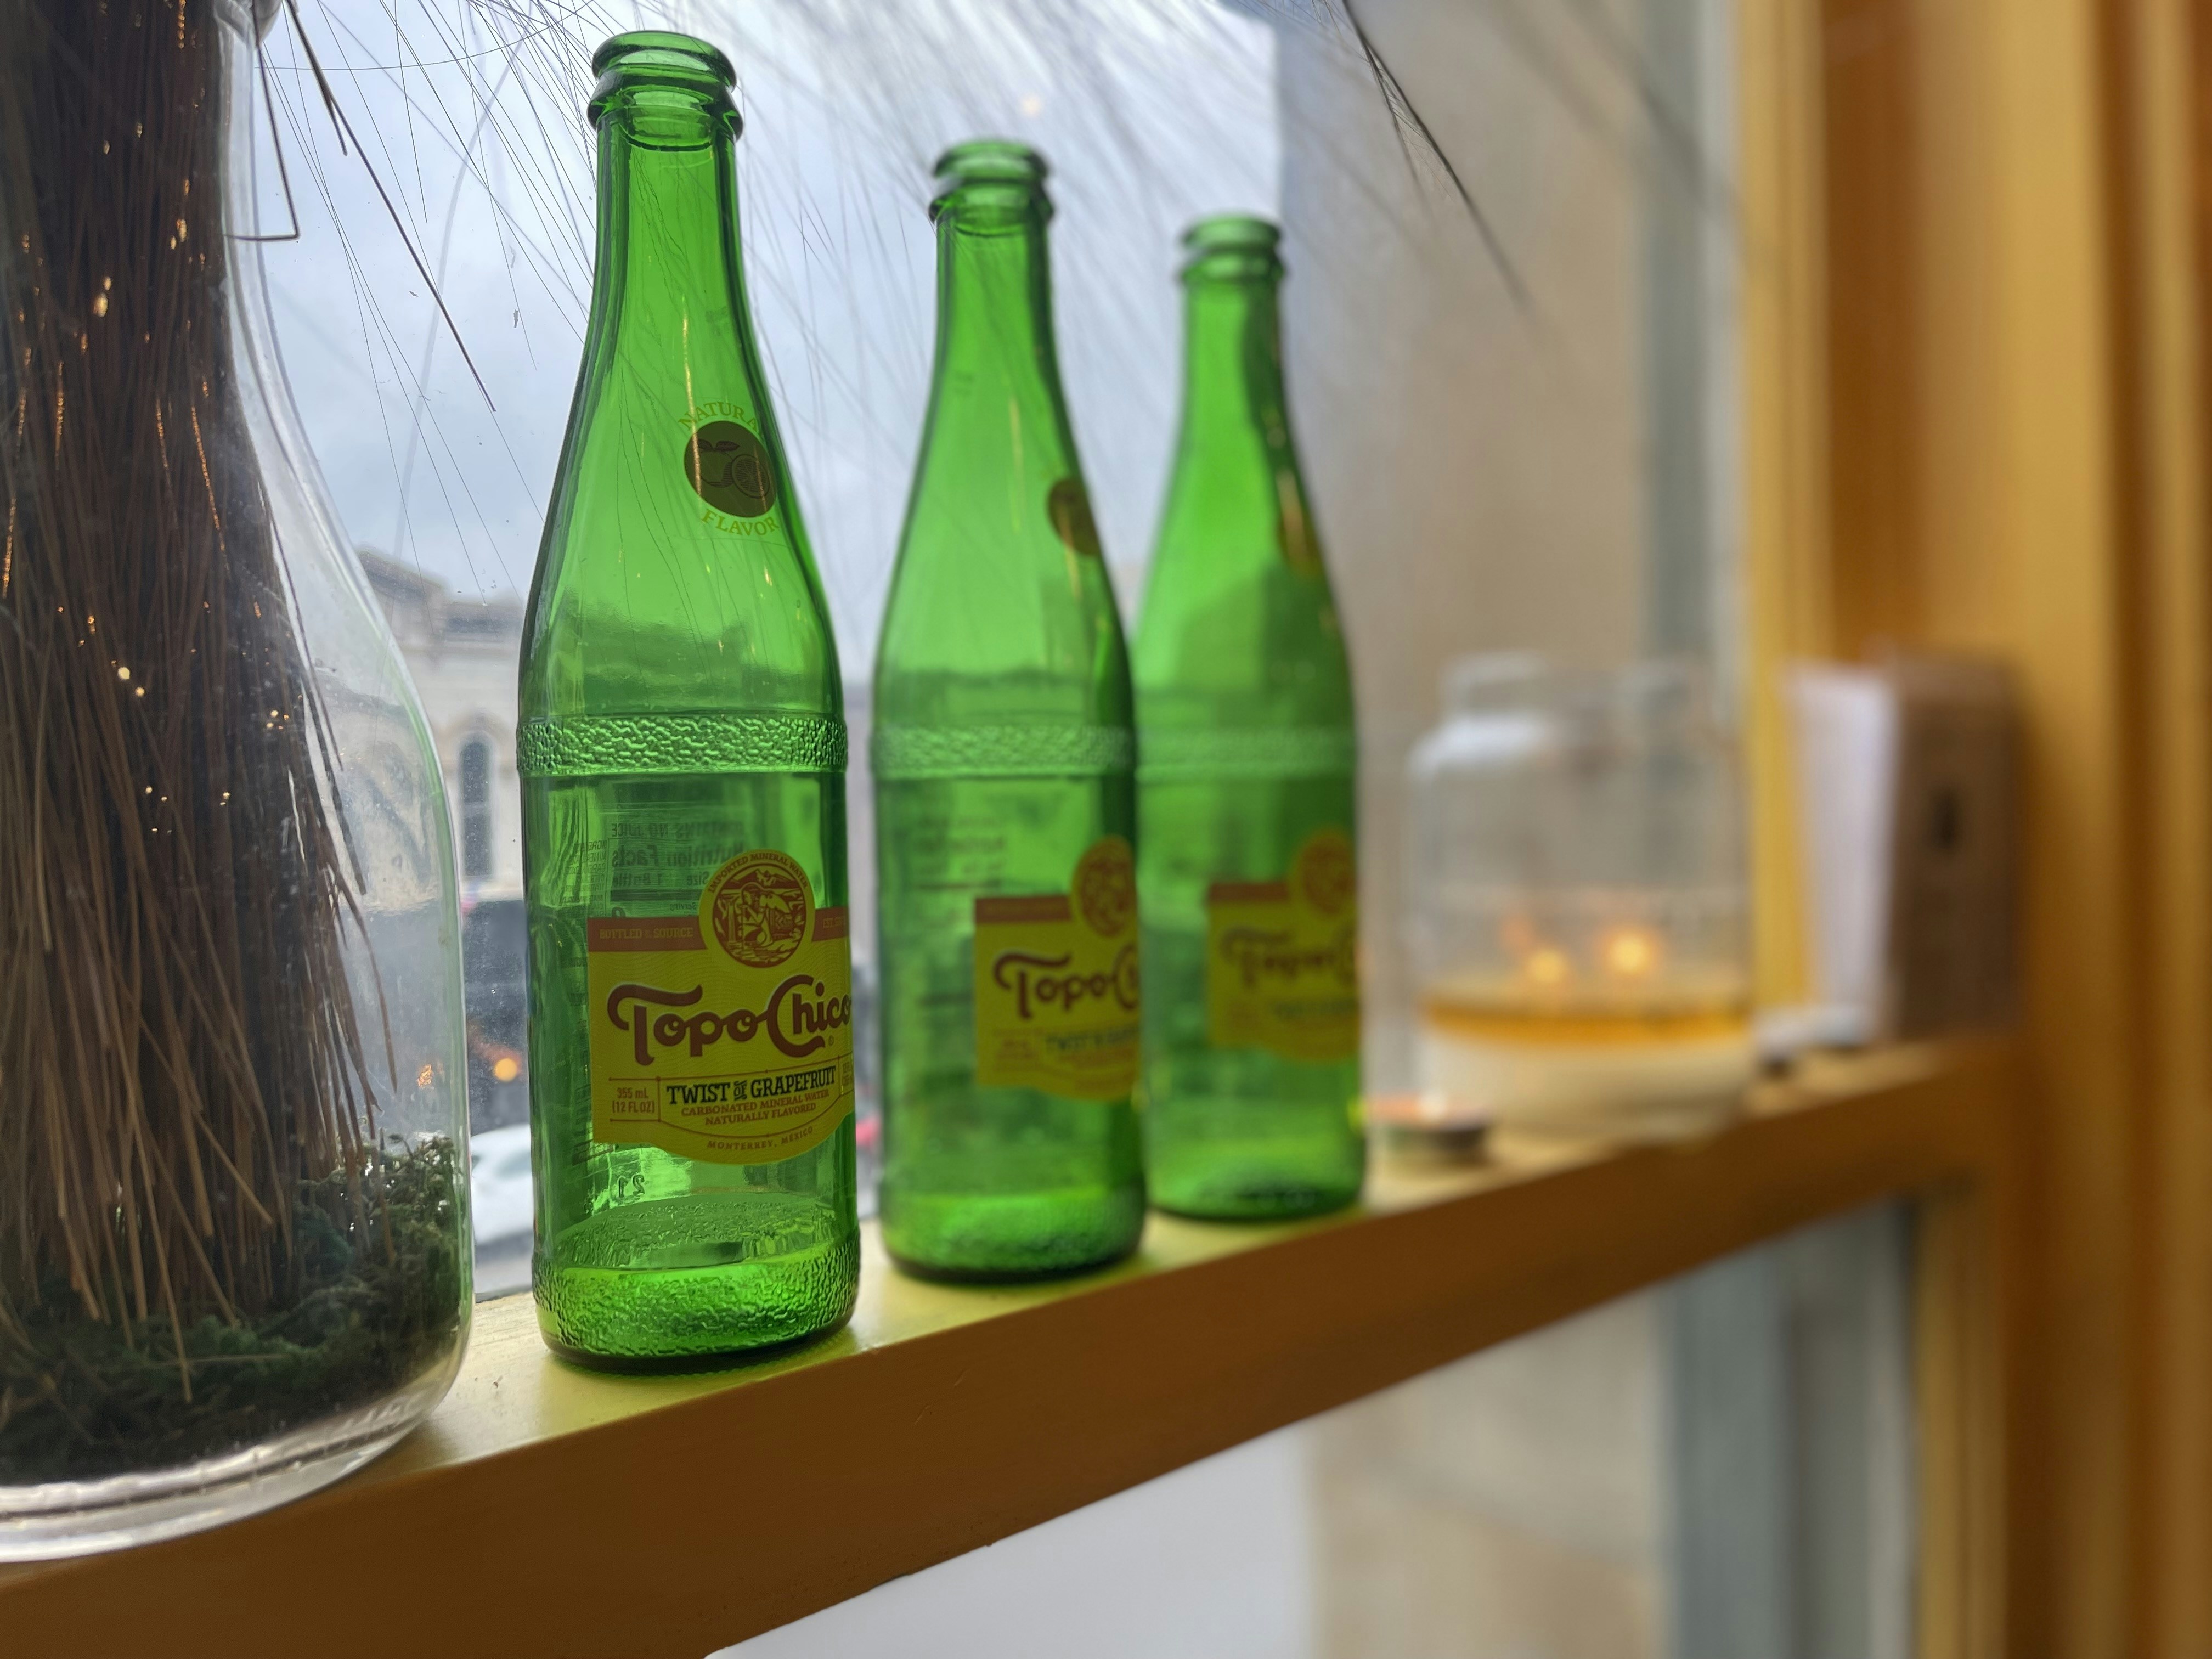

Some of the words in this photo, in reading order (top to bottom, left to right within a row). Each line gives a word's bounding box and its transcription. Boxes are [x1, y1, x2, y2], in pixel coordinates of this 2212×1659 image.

[678, 402, 761, 435] NATURA
[701, 509, 780, 536] FLAVOR
[708, 856, 748, 893] IMPORTED
[751, 853, 788, 866] MINERAL
[788, 860, 808, 889] WATER
[600, 928, 642, 939] BOTTLED
[653, 927, 693, 938] SOURCE
[992, 948, 1108, 1020] Topo
[607, 984, 763, 1065] Topo
[765, 974, 851, 1058] Chico
[617, 1087, 633, 1099] 355
[667, 1082, 731, 1105] TWIST
[751, 1065, 836, 1098] GRAPEFRUIT
[612, 1101, 625, 1113] (12
[628, 1101, 639, 1113] FL
[640, 1101, 655, 1113] OZ)
[681, 1102, 757, 1116] CARBONATED
[760, 1095, 803, 1109] MINERAL
[804, 1088, 829, 1101] WATER
[705, 1108, 769, 1125] NATURALLY
[771, 1102, 816, 1118] FLAVORED
